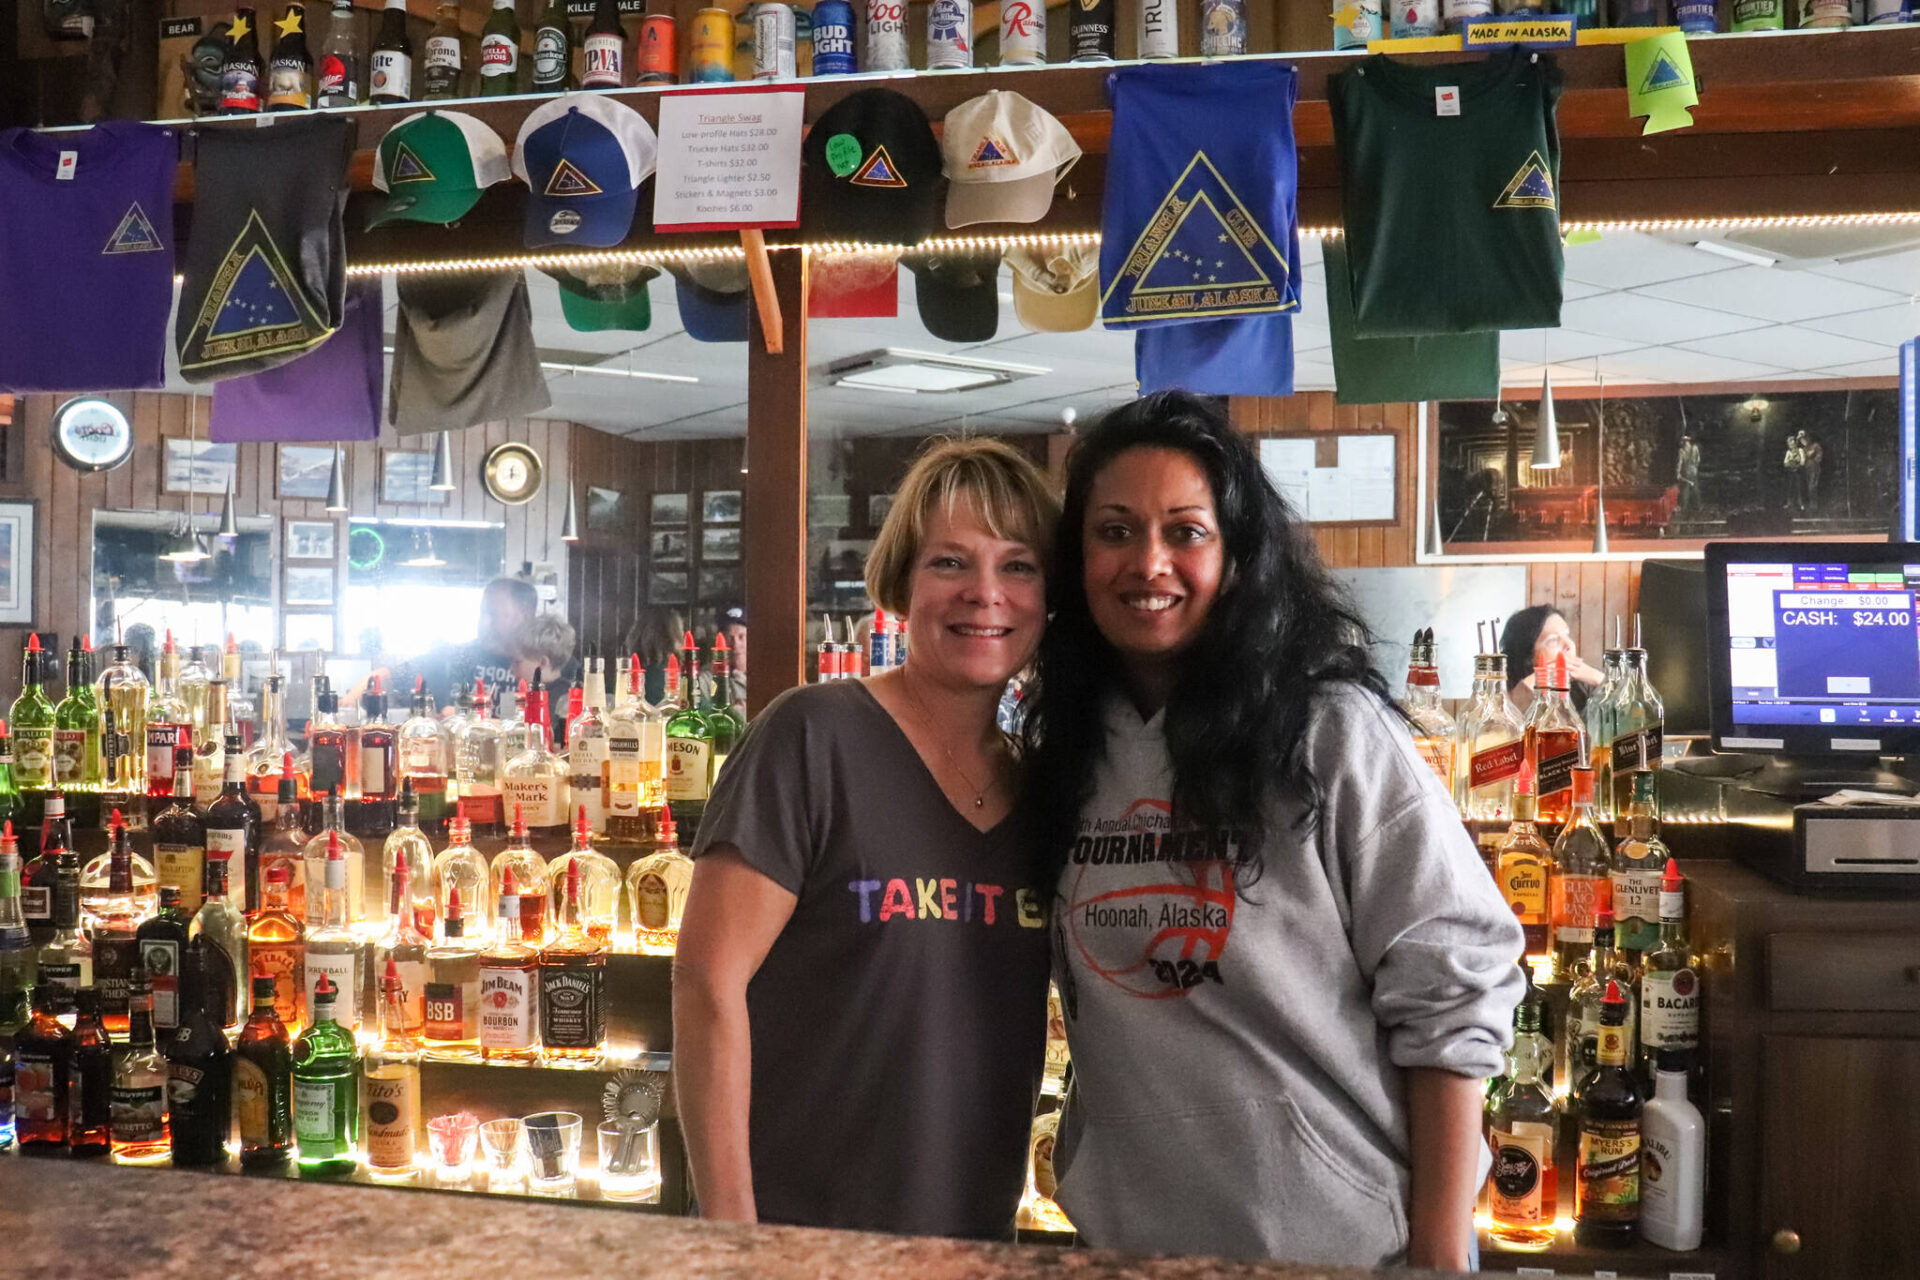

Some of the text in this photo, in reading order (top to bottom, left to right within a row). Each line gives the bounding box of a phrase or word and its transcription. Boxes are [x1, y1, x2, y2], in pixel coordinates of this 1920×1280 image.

[567, 2, 596, 14] KILLE
[865, 0, 909, 24] Coo
[1145, 0, 1163, 39] TRU
[168, 23, 195, 35] BEAR
[813, 25, 848, 39] BUD
[1071, 24, 1109, 36] GUINNESS
[1469, 26, 1568, 39] MADE IN ALASKA
[698, 113, 763, 124] Triangle Swag
[729, 129, 747, 138] Hats
[683, 174, 715, 184] Triangle
[747, 172, 771, 182] $2.50
[675, 188, 778, 199] Stickers & Magnets $3.00
[729, 203, 753, 213] $6.00
[1800, 595, 1889, 607] Change: $0.00
[1782, 611, 1910, 627] CASH: $24.00
[148, 730, 180, 745] MPARI
[667, 742, 701, 756] MESON
[1474, 762, 1494, 774] Red
[504, 782, 548, 792] Maker's
[516, 791, 548, 802] Mark
[1133, 812, 1171, 830] Chicha
[1073, 830, 1246, 866] OURNAMENT
[1510, 876, 1541, 891] Cuervo
[1615, 883, 1660, 896] GLENLIVET
[848, 876, 1044, 929] TAKE IT E
[1629, 895, 1642, 906] 12
[1084, 902, 1229, 929] Hoonah, Alaska
[480, 975, 523, 996] JIM BEAM
[544, 975, 591, 994] JACK DANIEL'S
[1657, 996, 1698, 1010] BACAR
[426, 1001, 455, 1022] BSB
[483, 1015, 519, 1027] BOURBON
[553, 1016, 582, 1024] WHISKEY
[366, 1082, 403, 1098] Tito's
[1600, 1146, 1624, 1156] RUM
